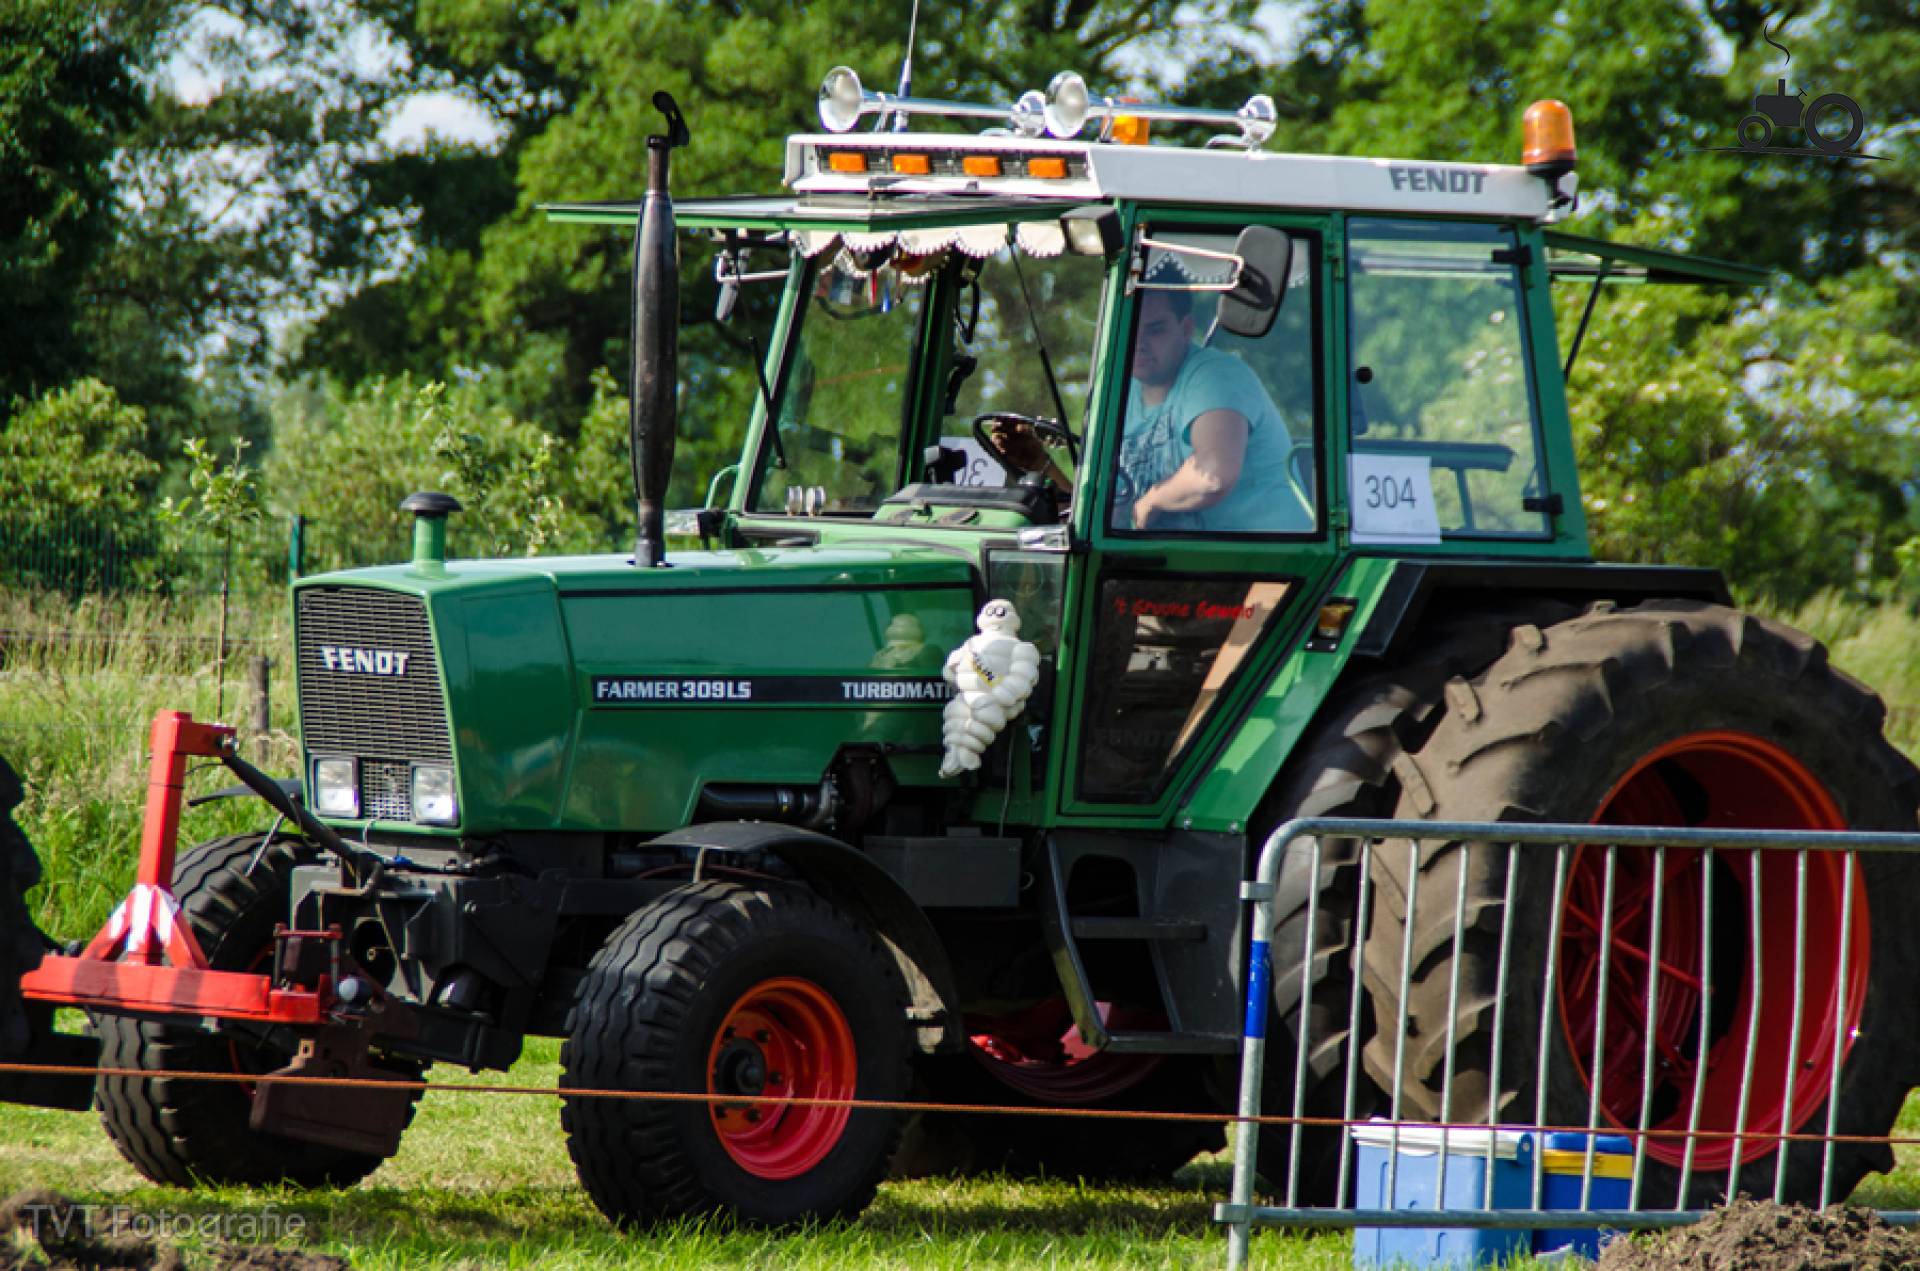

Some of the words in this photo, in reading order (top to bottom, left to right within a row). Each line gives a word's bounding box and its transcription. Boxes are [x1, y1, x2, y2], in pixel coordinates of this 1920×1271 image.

[1389, 167, 1488, 194] FENDT
[1365, 475, 1416, 509] 304
[321, 645, 411, 676] FENDT
[596, 680, 679, 699] FARMER
[842, 681, 951, 699] TURBOMATI
